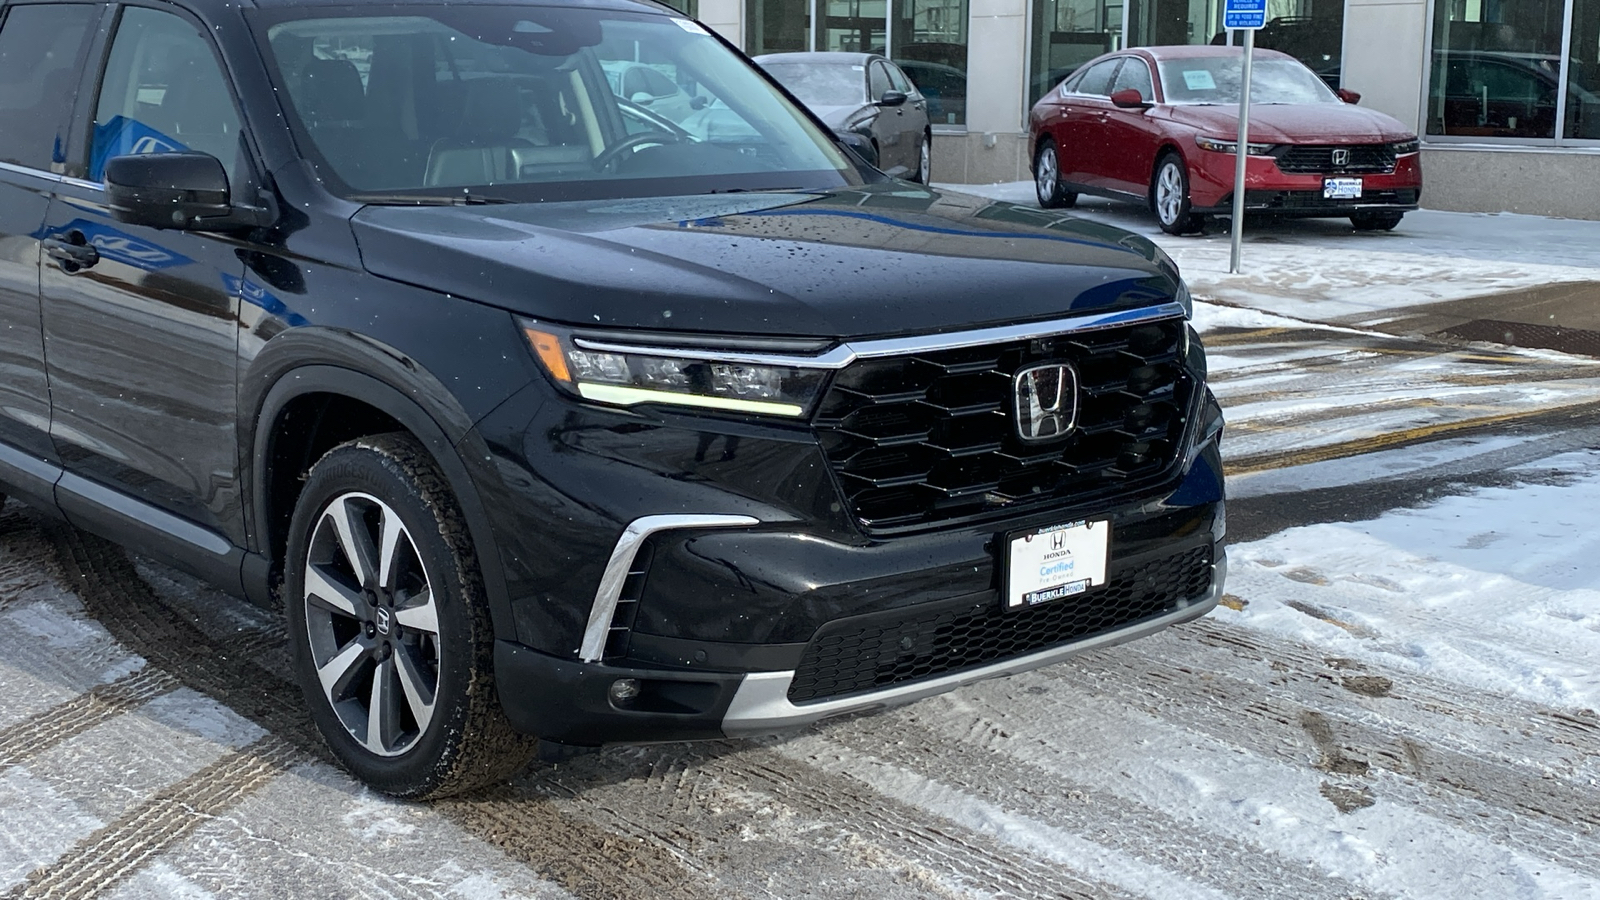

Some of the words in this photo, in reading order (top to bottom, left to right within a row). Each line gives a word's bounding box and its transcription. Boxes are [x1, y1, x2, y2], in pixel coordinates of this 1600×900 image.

[1043, 549, 1071, 560] HONDA
[1039, 560, 1074, 576] Certified
[1031, 587, 1064, 603] BUERKLE
[1065, 584, 1085, 595] HONDA
